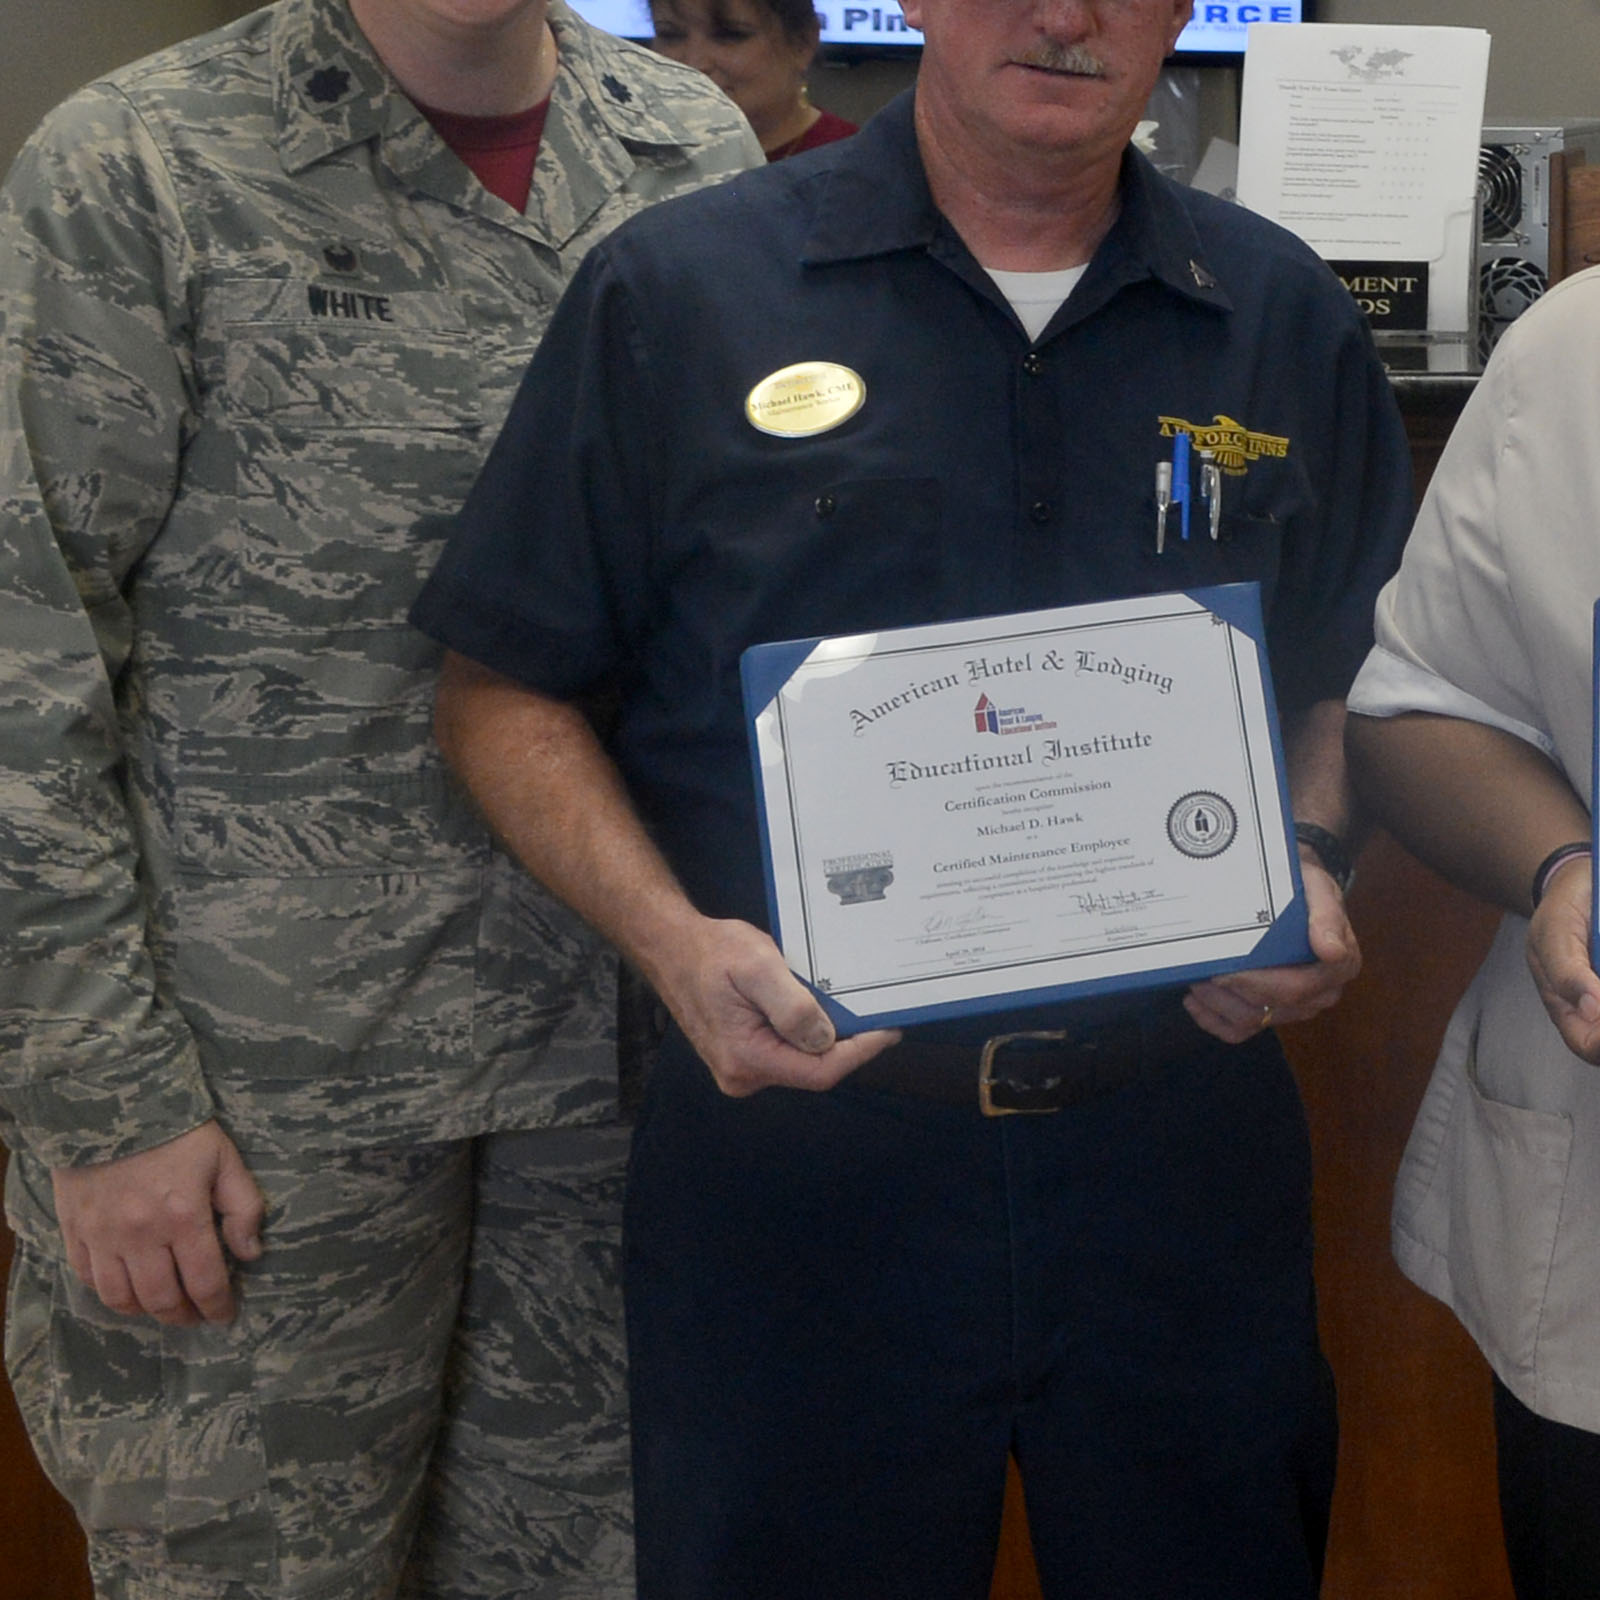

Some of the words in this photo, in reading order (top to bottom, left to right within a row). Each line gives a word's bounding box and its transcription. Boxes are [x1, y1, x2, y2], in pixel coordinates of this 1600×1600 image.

[1195, 5, 1292, 24] RCE
[308, 284, 394, 322] WHITE
[1194, 430, 1247, 447] FORC
[1249, 439, 1287, 457] INNS
[850, 673, 959, 737] American
[964, 653, 1032, 687] Hotel
[1041, 650, 1064, 671] &
[1075, 650, 1174, 694] Lodging
[887, 745, 1032, 789] Educational
[1041, 731, 1152, 767] Institute
[944, 790, 1026, 813] Certification
[1030, 779, 1112, 800] Commission
[977, 819, 1027, 837] Michael
[1028, 817, 1043, 830] D.
[1047, 812, 1084, 827] Hawk
[933, 854, 986, 874] Certified
[989, 845, 1067, 866] Maintenance
[1070, 836, 1131, 855] Employee
